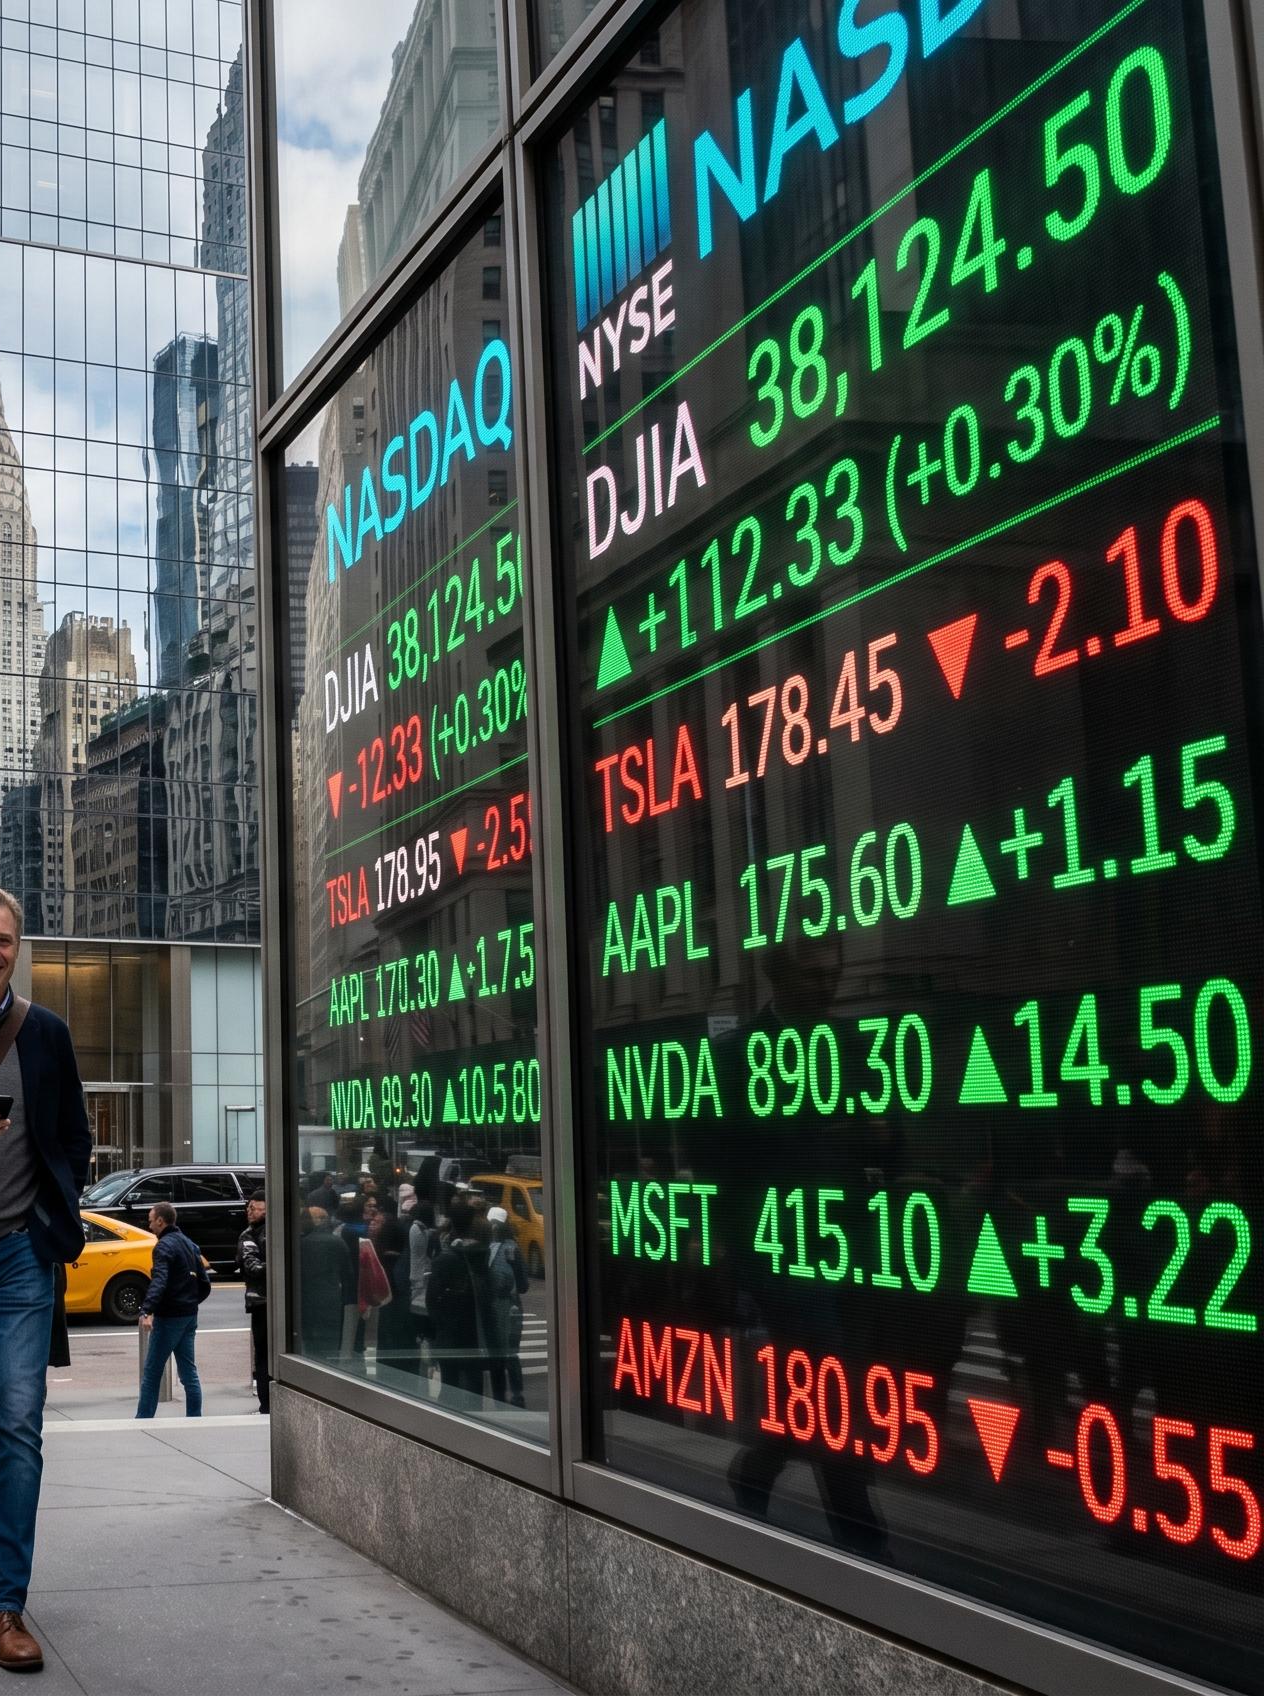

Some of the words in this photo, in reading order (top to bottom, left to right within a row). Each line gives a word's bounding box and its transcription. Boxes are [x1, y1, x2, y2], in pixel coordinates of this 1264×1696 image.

[579, 260, 675, 400] NYSE
[586, 401, 707, 560] DJIA
[747, 46, 1170, 448] 38,124.50
[326, 339, 512, 583] NASDAQ
[639, 458, 864, 651] +112.33
[886, 271, 1191, 552] (+0.30%)
[324, 643, 378, 734] DJIA
[595, 724, 703, 832] TSLA
[722, 633, 903, 789] 178.45
[1005, 499, 1217, 677] -2.10
[349, 713, 422, 808] -12.33
[326, 866, 369, 928] TSLA
[374, 831, 441, 912] 178.95
[477, 792, 532, 871] -2.5
[602, 881, 709, 975] AAPL
[740, 822, 922, 949] 175.60
[1001, 735, 1235, 889] +1.15
[329, 971, 369, 1027] AAPL
[376, 950, 439, 1018] 170.30
[607, 1039, 722, 1120] NVDA
[747, 1014, 933, 1117] 890.30
[1014, 978, 1251, 1107] 14.50
[330, 1078, 376, 1130] NVDA
[381, 1071, 432, 1129] 89.30
[610, 1181, 717, 1266] MSFT
[754, 1187, 940, 1292] 415.10
[1022, 1198, 1257, 1332] +3.22
[615, 1317, 734, 1421] AMZN
[757, 1345, 938, 1474] 180.95
[1046, 1404, 1261, 1559] -0.55
